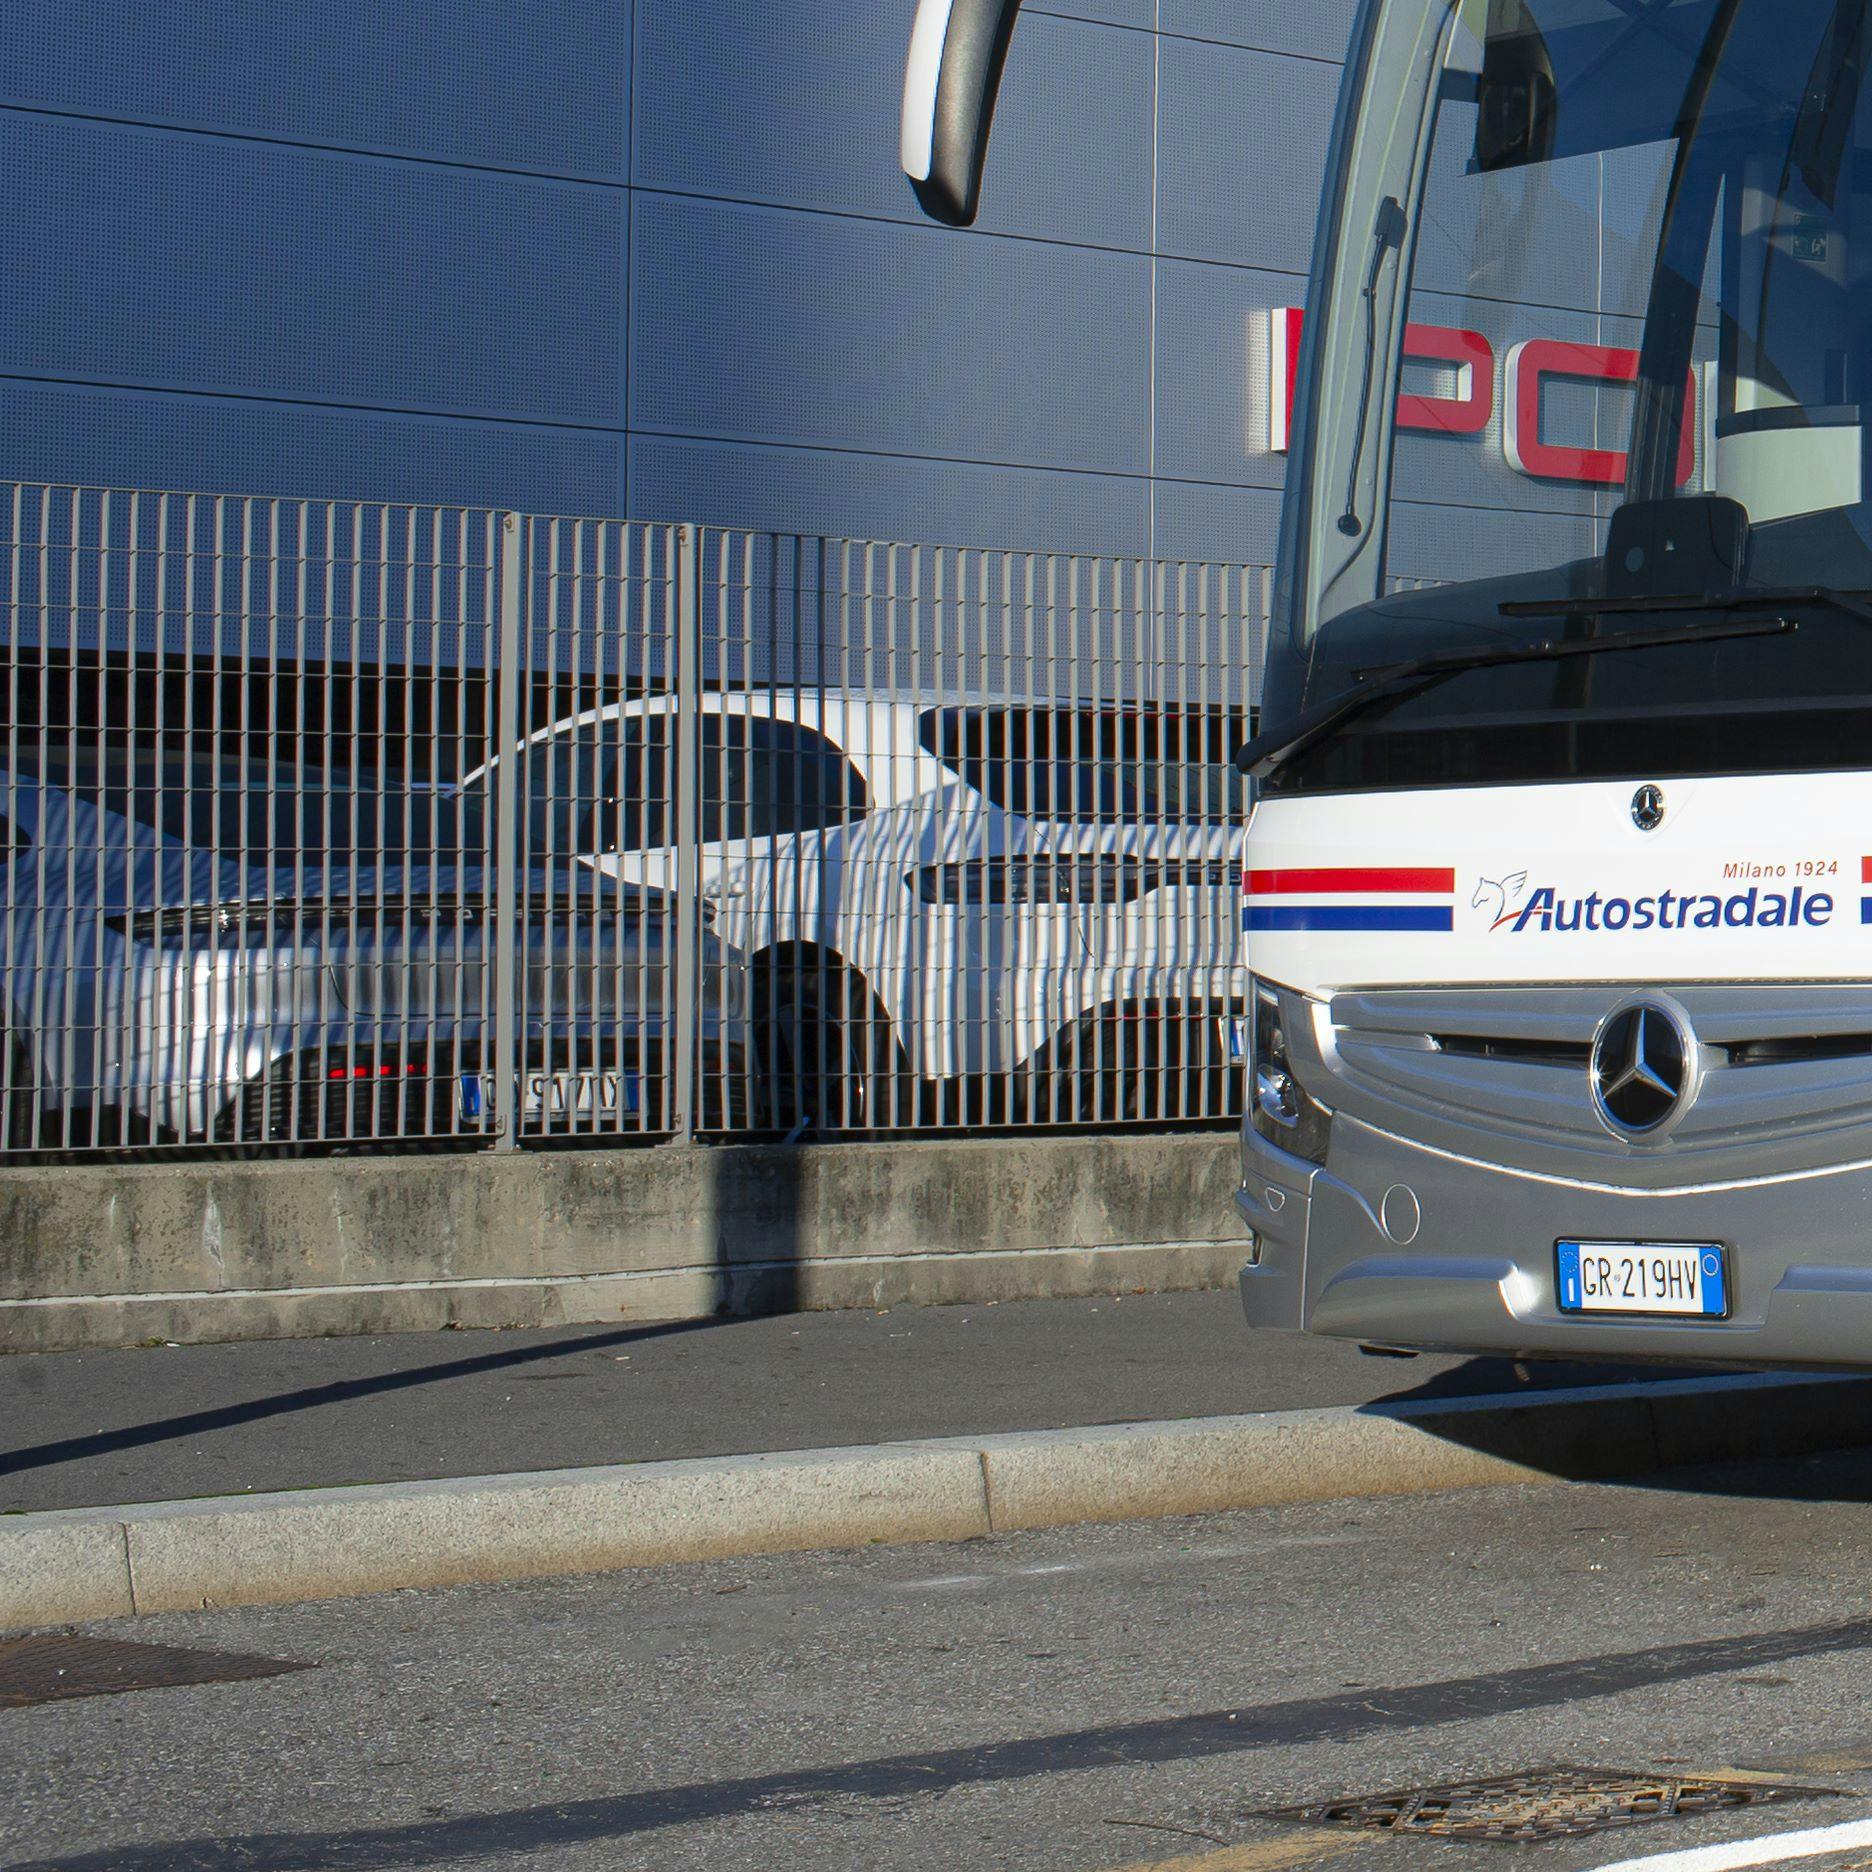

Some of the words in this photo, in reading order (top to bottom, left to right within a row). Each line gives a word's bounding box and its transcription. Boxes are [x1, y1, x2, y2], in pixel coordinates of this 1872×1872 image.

[1723, 863, 1786, 879] Milano
[1795, 860, 1839, 877] 1924
[1511, 886, 1834, 932] Autostradale
